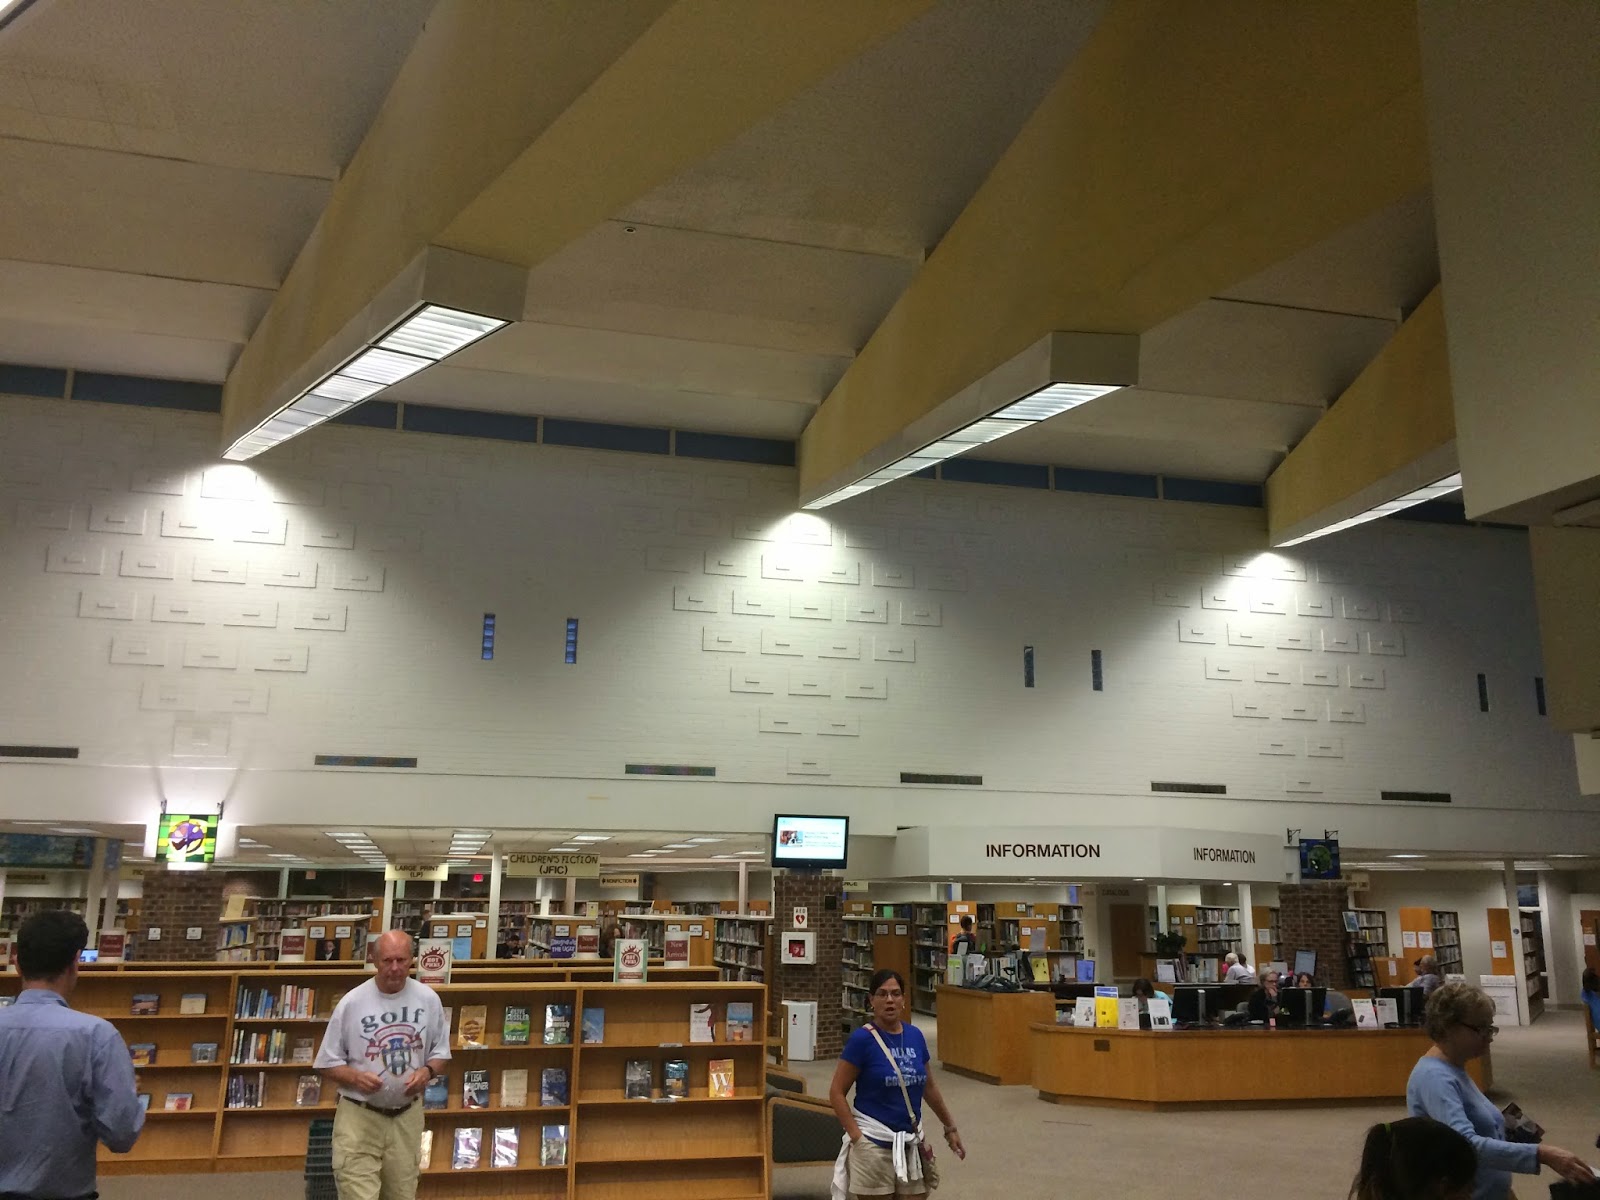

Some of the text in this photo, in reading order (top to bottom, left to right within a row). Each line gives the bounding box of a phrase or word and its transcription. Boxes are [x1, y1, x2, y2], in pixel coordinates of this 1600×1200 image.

[985, 844, 1101, 858] INFORMATION
[1193, 847, 1256, 864] INFORMATION
[510, 854, 599, 865] CHILDREN'S FICTION
[539, 865, 569, 875] (JFIC)
[360, 1006, 425, 1034] golf
[886, 1047, 917, 1058] ALLAS
[885, 1074, 928, 1087] COBOYS
